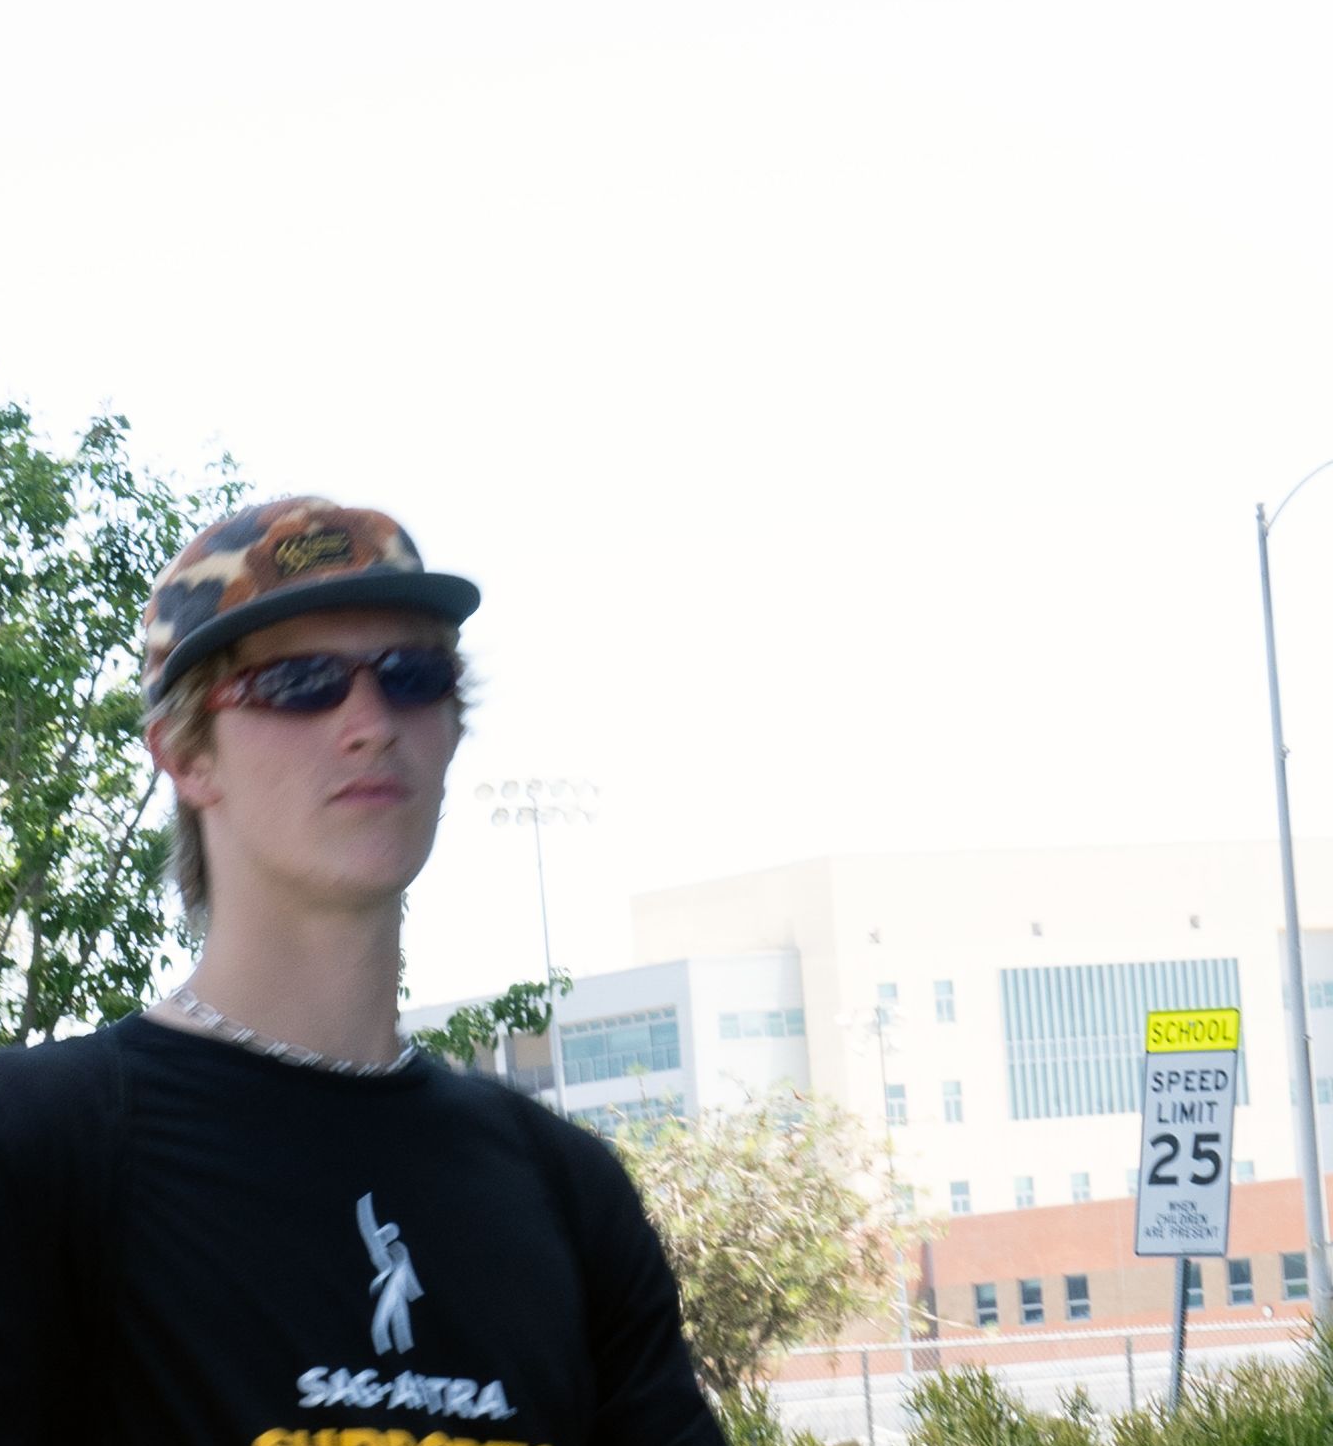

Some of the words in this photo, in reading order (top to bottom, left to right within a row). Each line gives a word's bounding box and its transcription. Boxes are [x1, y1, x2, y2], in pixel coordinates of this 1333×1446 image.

[1151, 1019, 1234, 1044] SCHOOL
[1151, 1070, 1228, 1093] SPEED
[1157, 1102, 1219, 1124] LIMIT
[1148, 1132, 1222, 1186] 25
